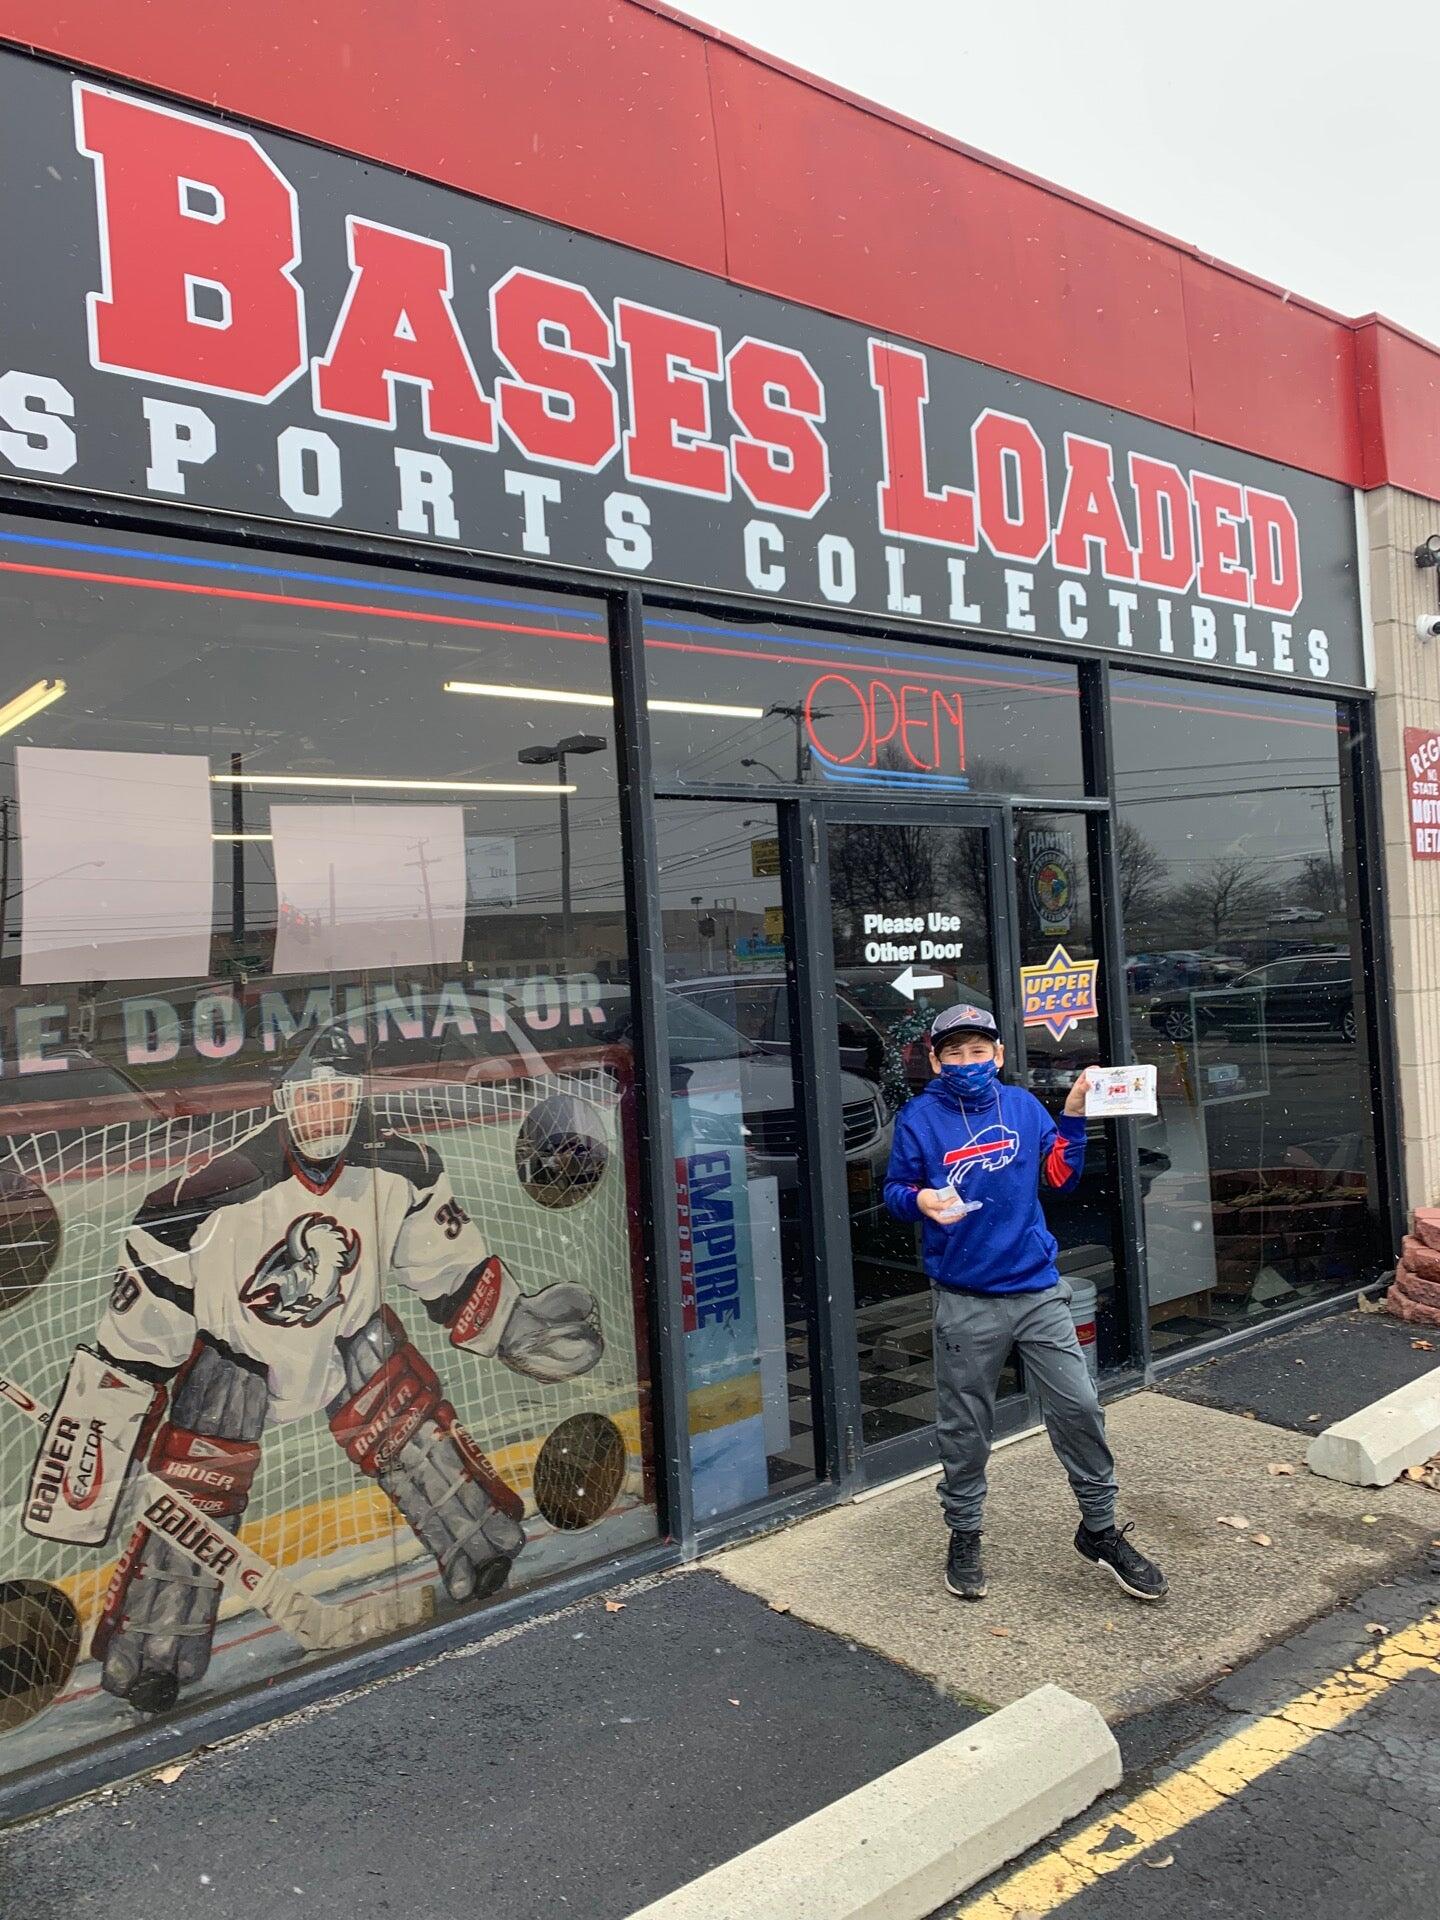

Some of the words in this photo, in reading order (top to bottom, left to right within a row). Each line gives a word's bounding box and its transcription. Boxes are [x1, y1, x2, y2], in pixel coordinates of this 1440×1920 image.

[72, 80, 831, 519] BASES
[867, 336, 1303, 617] LOADED
[0, 370, 653, 571] SPORTS
[743, 519, 1330, 678] COLLECTIBLES
[805, 673, 966, 771] OPEN
[1412, 782, 1439, 796] STATE
[864, 913, 925, 935] Please
[928, 912, 961, 932] Use
[865, 942, 917, 963] Other
[920, 940, 963, 960] Door
[122, 972, 607, 1065] DOMINATOR
[1026, 973, 1091, 995] UPPER
[675, 1183, 694, 1308] SPORTS
[687, 1150, 741, 1329] EMPIRE
